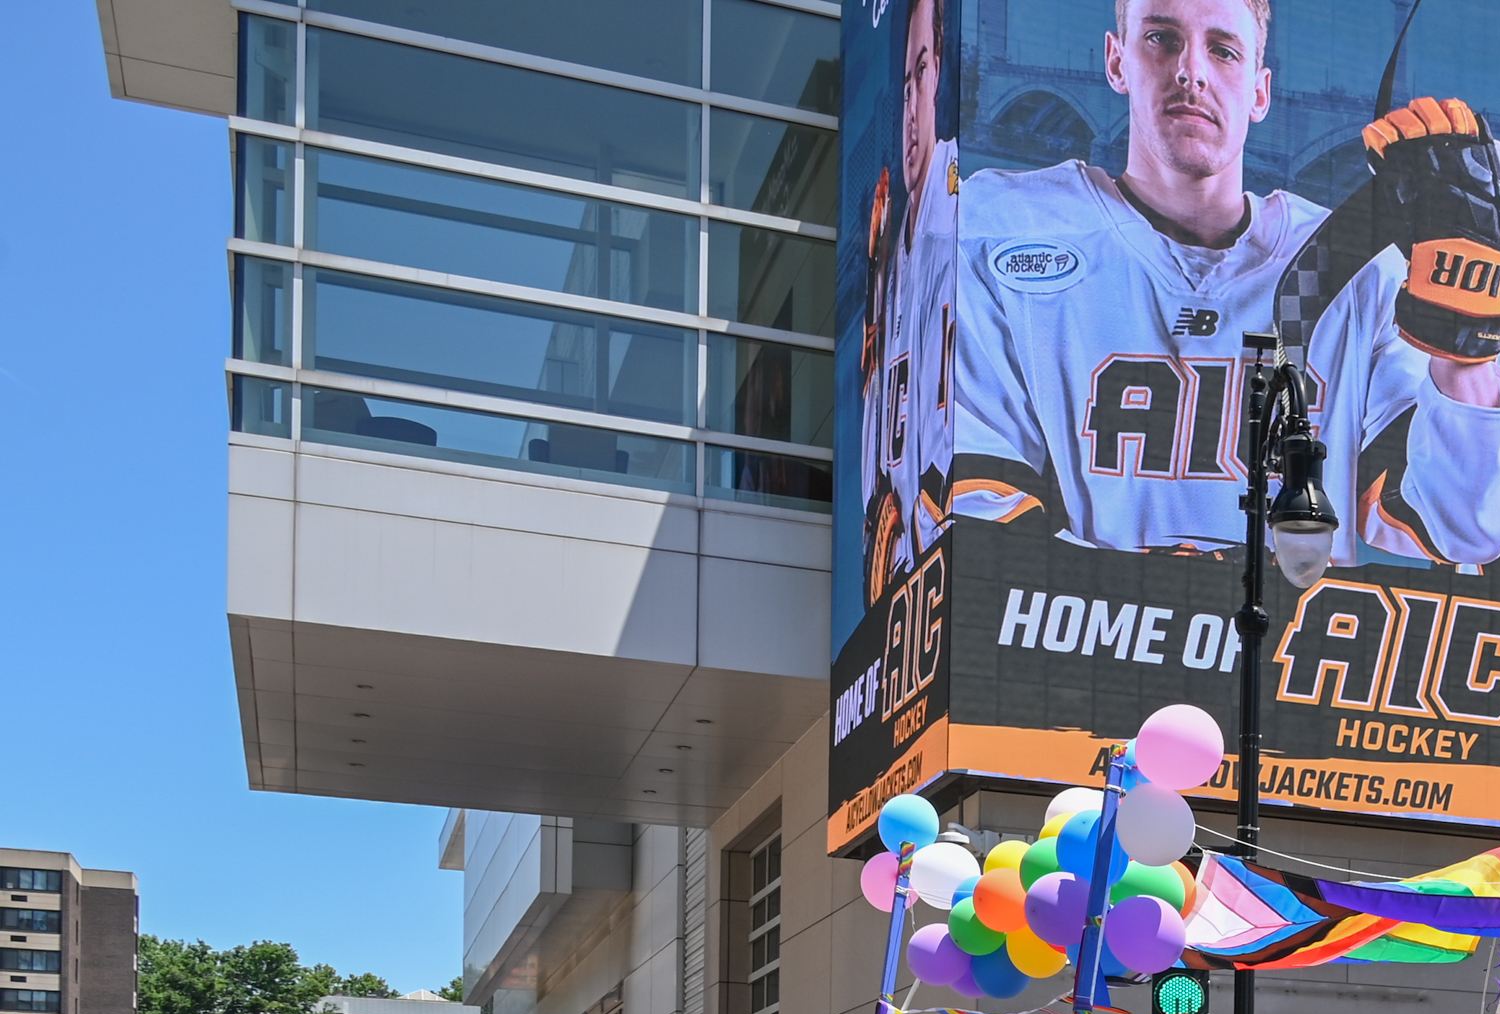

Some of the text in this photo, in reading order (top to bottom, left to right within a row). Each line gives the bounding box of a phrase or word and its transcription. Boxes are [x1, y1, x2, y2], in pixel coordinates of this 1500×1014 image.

[1006, 261, 1047, 274] hockey
[1010, 252, 1053, 264] atlantic
[881, 547, 945, 723] AIC
[997, 588, 1174, 665] HOME
[834, 657, 881, 747] HOME OF
[893, 695, 929, 749] HOCKEY
[1336, 717, 1479, 760] HOCKEY
